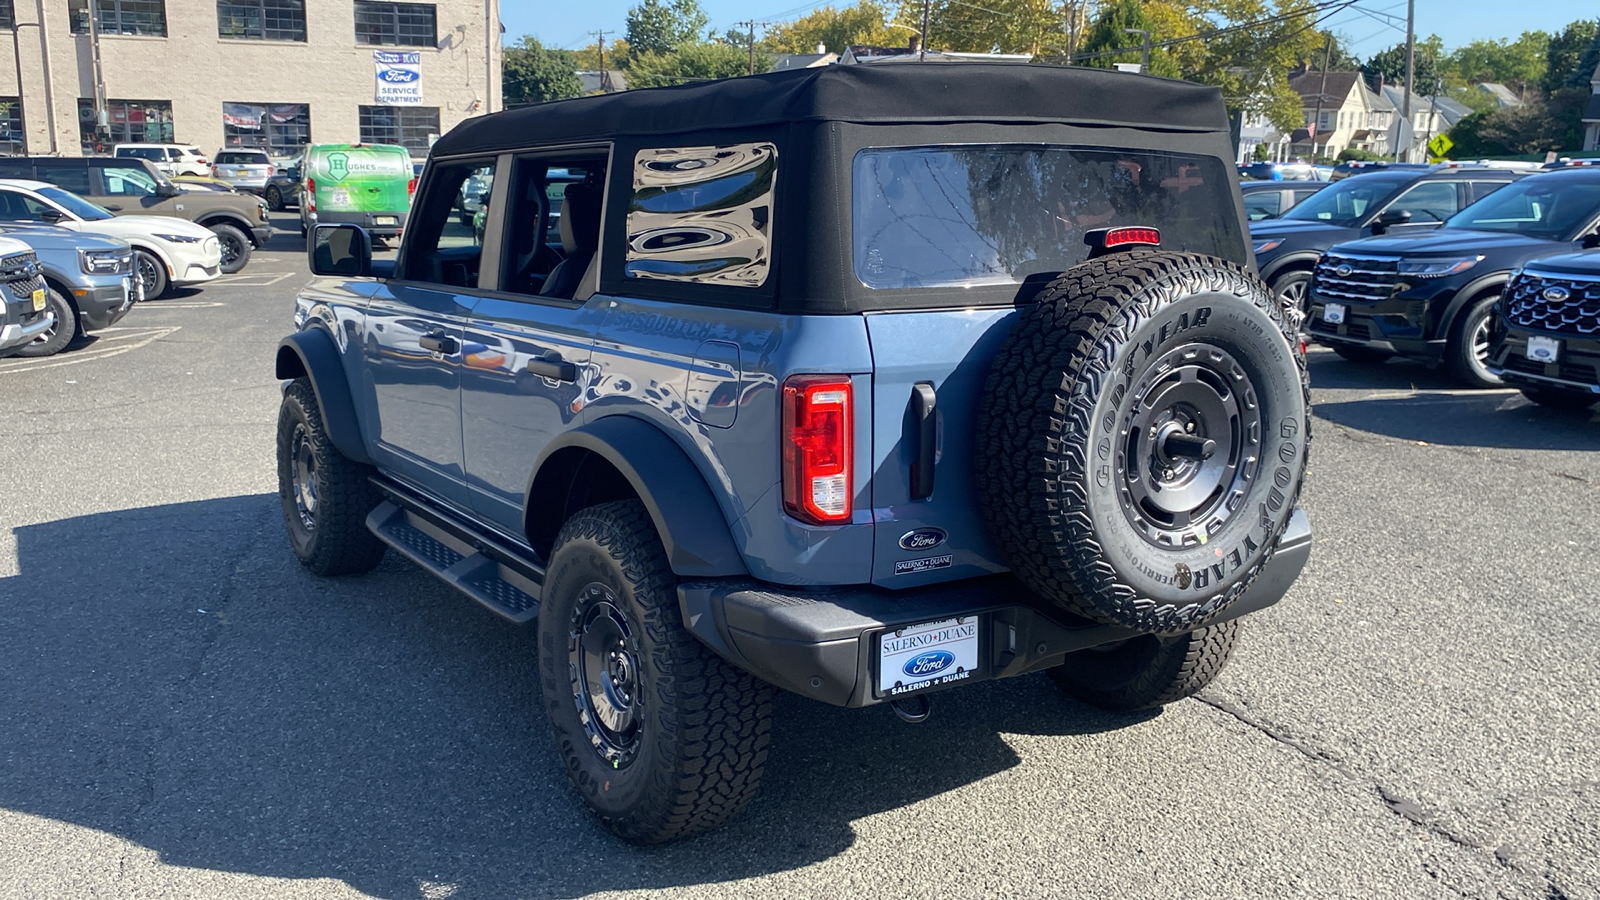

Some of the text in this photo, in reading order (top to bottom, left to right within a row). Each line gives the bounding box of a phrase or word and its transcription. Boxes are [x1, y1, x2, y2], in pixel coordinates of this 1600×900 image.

[385, 70, 412, 82] Ford
[614, 310, 714, 340] SASQUATCH
[911, 533, 936, 547] Ford
[1120, 542, 1174, 586] TERRITORY
[883, 634, 933, 653] SALERNO
[938, 624, 975, 642] DUANE
[913, 655, 945, 673] Ford
[891, 671, 970, 695] SALERNO DUANE
